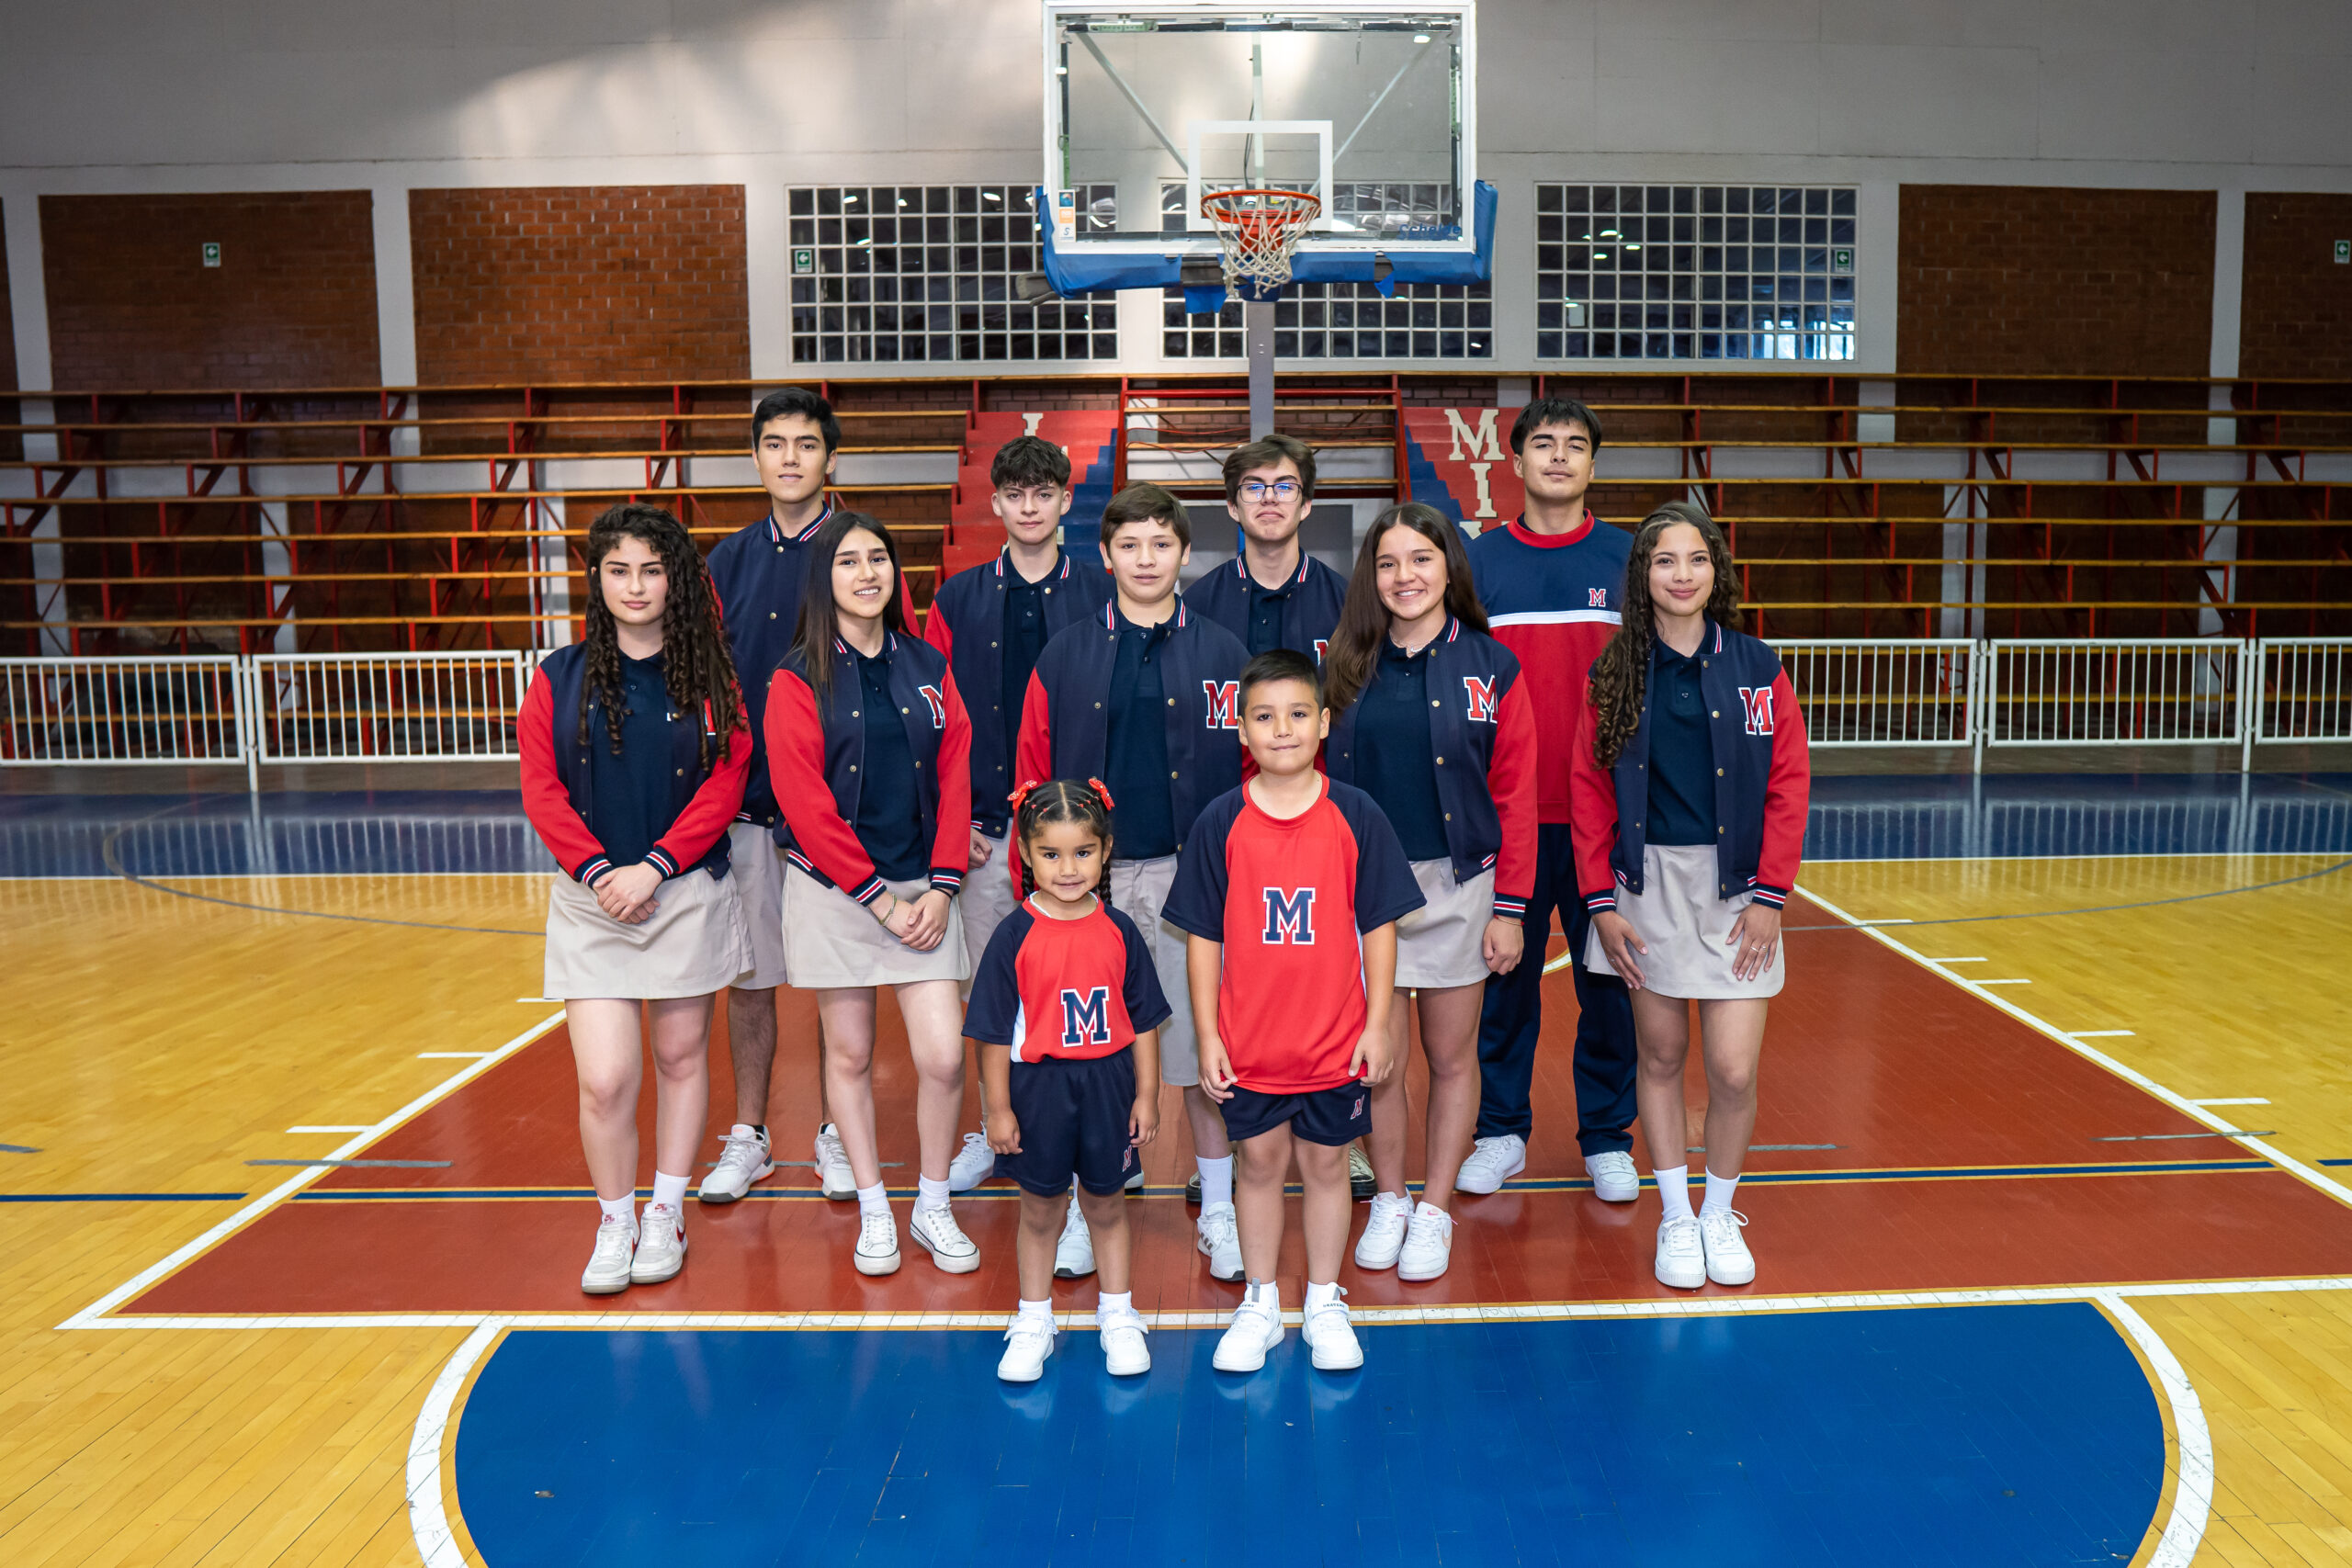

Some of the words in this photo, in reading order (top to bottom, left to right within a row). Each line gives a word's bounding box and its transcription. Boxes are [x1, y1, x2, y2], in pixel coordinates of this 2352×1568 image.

[1589, 588, 1606, 607] M
[1203, 680, 1239, 728] M
[1463, 675, 1498, 724] M
[1738, 686, 1774, 736] M
[1261, 886, 1316, 945] M
[1060, 986, 1111, 1047] M
